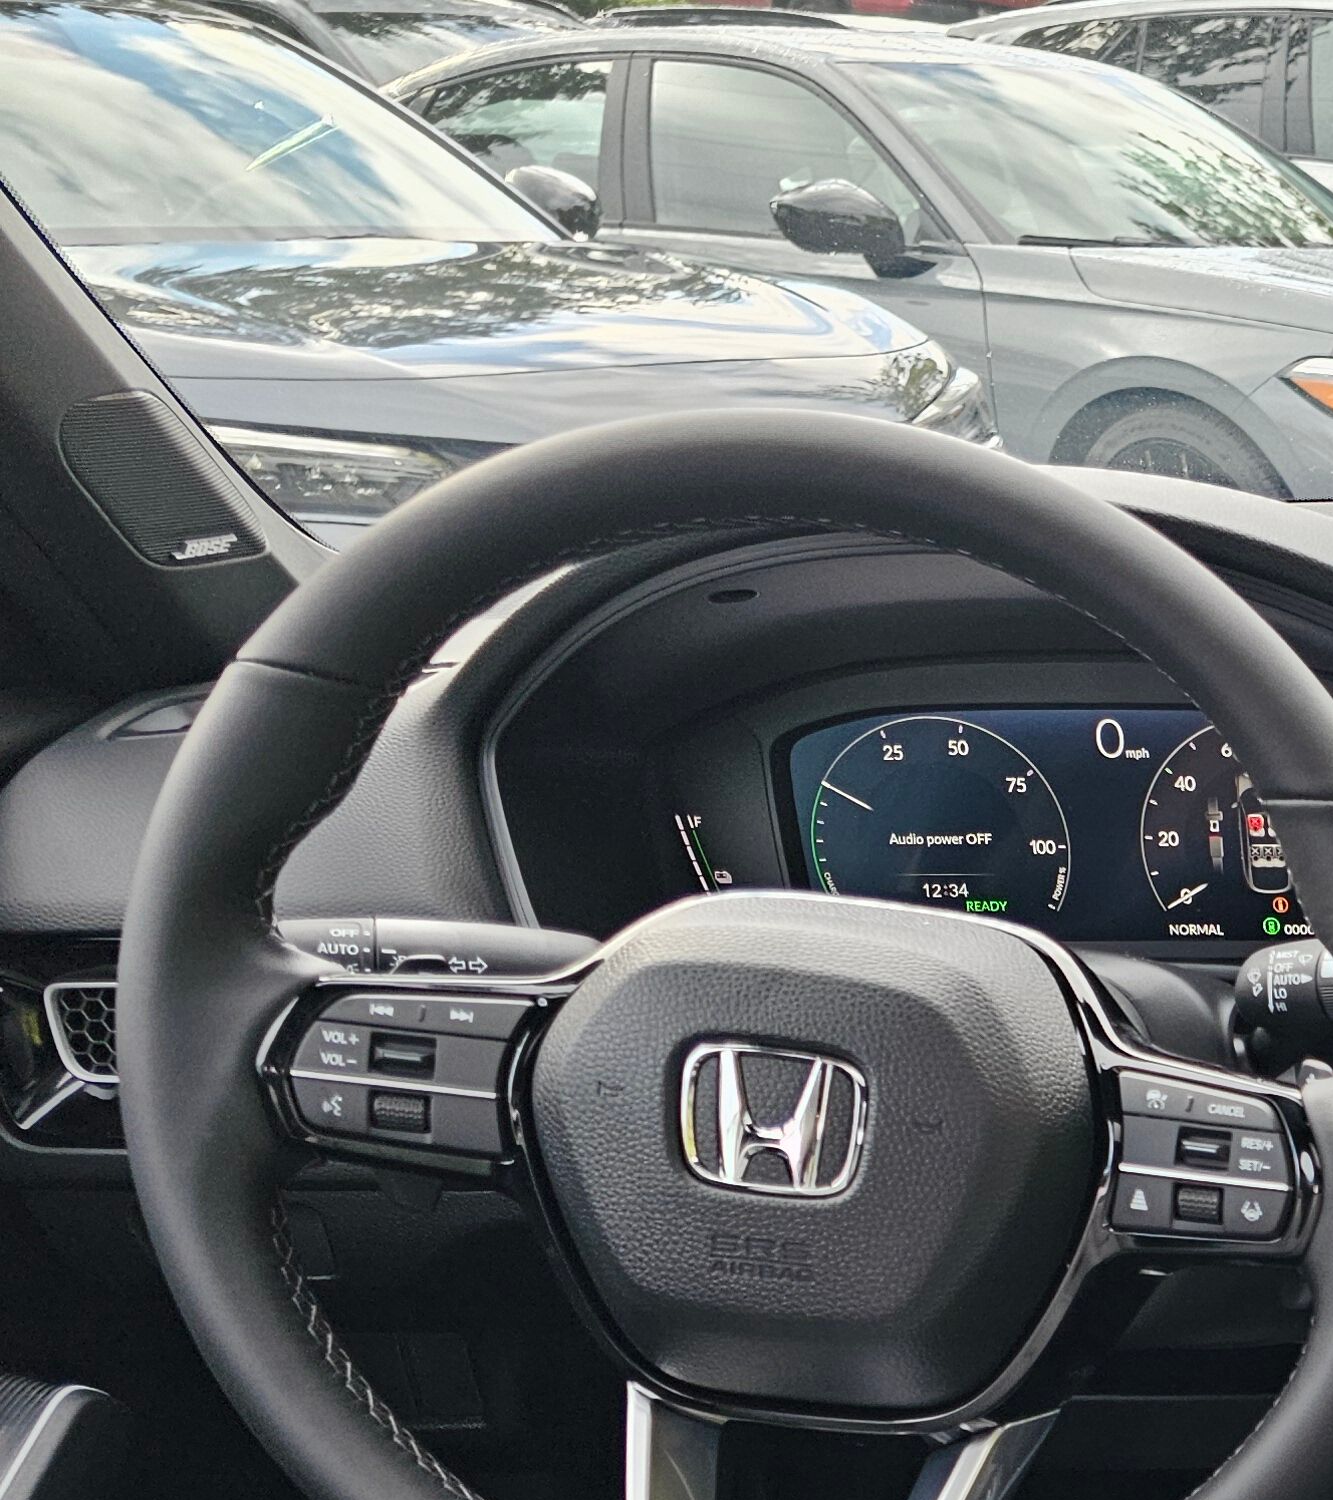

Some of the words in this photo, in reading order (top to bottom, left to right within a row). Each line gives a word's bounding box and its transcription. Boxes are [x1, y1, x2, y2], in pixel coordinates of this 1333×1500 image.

[1096, 718, 1124, 759] 0
[1125, 748, 1150, 760] mph
[883, 745, 904, 761] 25
[948, 740, 969, 756] 50
[1006, 777, 1027, 793] 75
[1174, 776, 1197, 792] 40
[889, 833, 924, 845] Audio
[927, 835, 964, 848] power
[966, 833, 993, 845] OFF
[1158, 831, 1180, 847] 20
[1030, 840, 1057, 855] 100
[922, 883, 970, 898] 12:34
[966, 901, 1008, 913] READY
[330, 929, 358, 938] OFF
[1169, 924, 1225, 936] NORMAL
[317, 943, 359, 955] AUTO
[1273, 962, 1295, 973] OFF
[1273, 973, 1300, 986] AUTO
[1273, 987, 1288, 999] LO
[1275, 1001, 1288, 1012] HI
[1207, 1103, 1246, 1118] CANCEL
